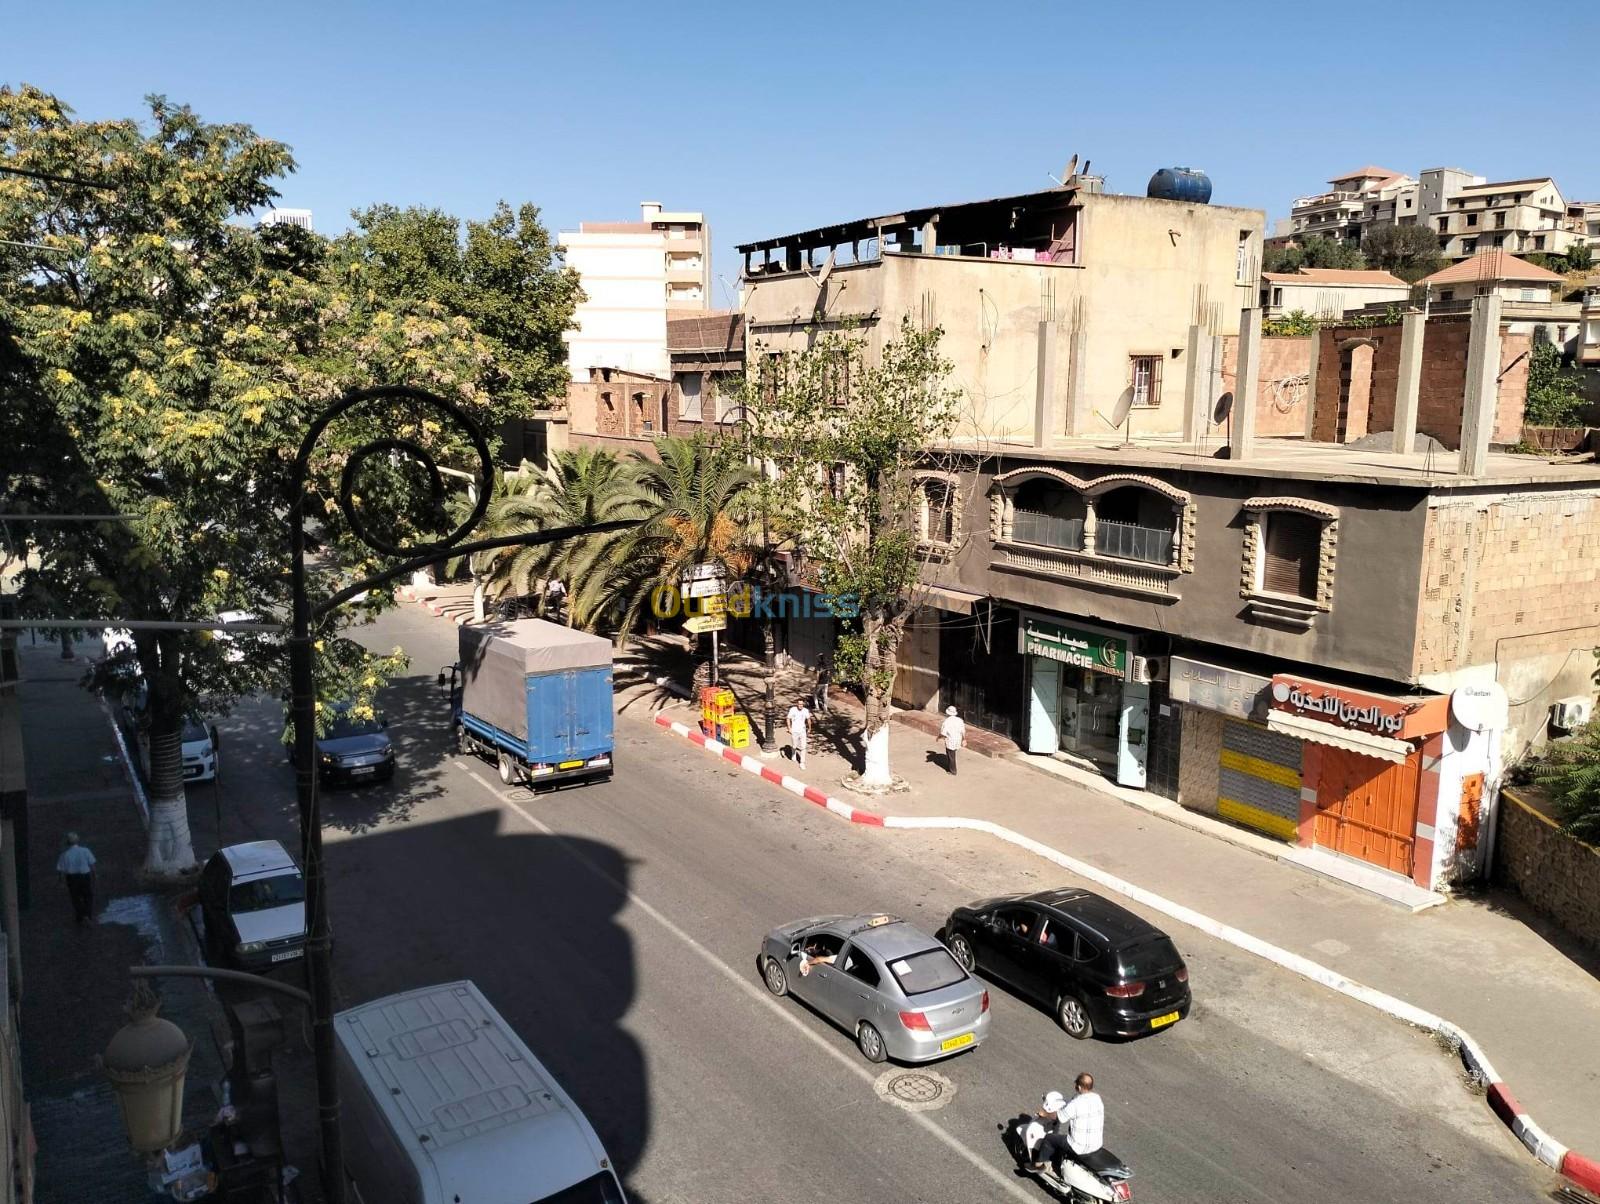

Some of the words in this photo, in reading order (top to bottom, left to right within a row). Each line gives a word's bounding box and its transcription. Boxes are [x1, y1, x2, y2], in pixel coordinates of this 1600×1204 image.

[1027, 642, 1093, 668] PHARMACIE
[1290, 682, 1340, 716] للأحذية
[1339, 700, 1378, 727] الدين
[1377, 710, 1404, 733] نور
